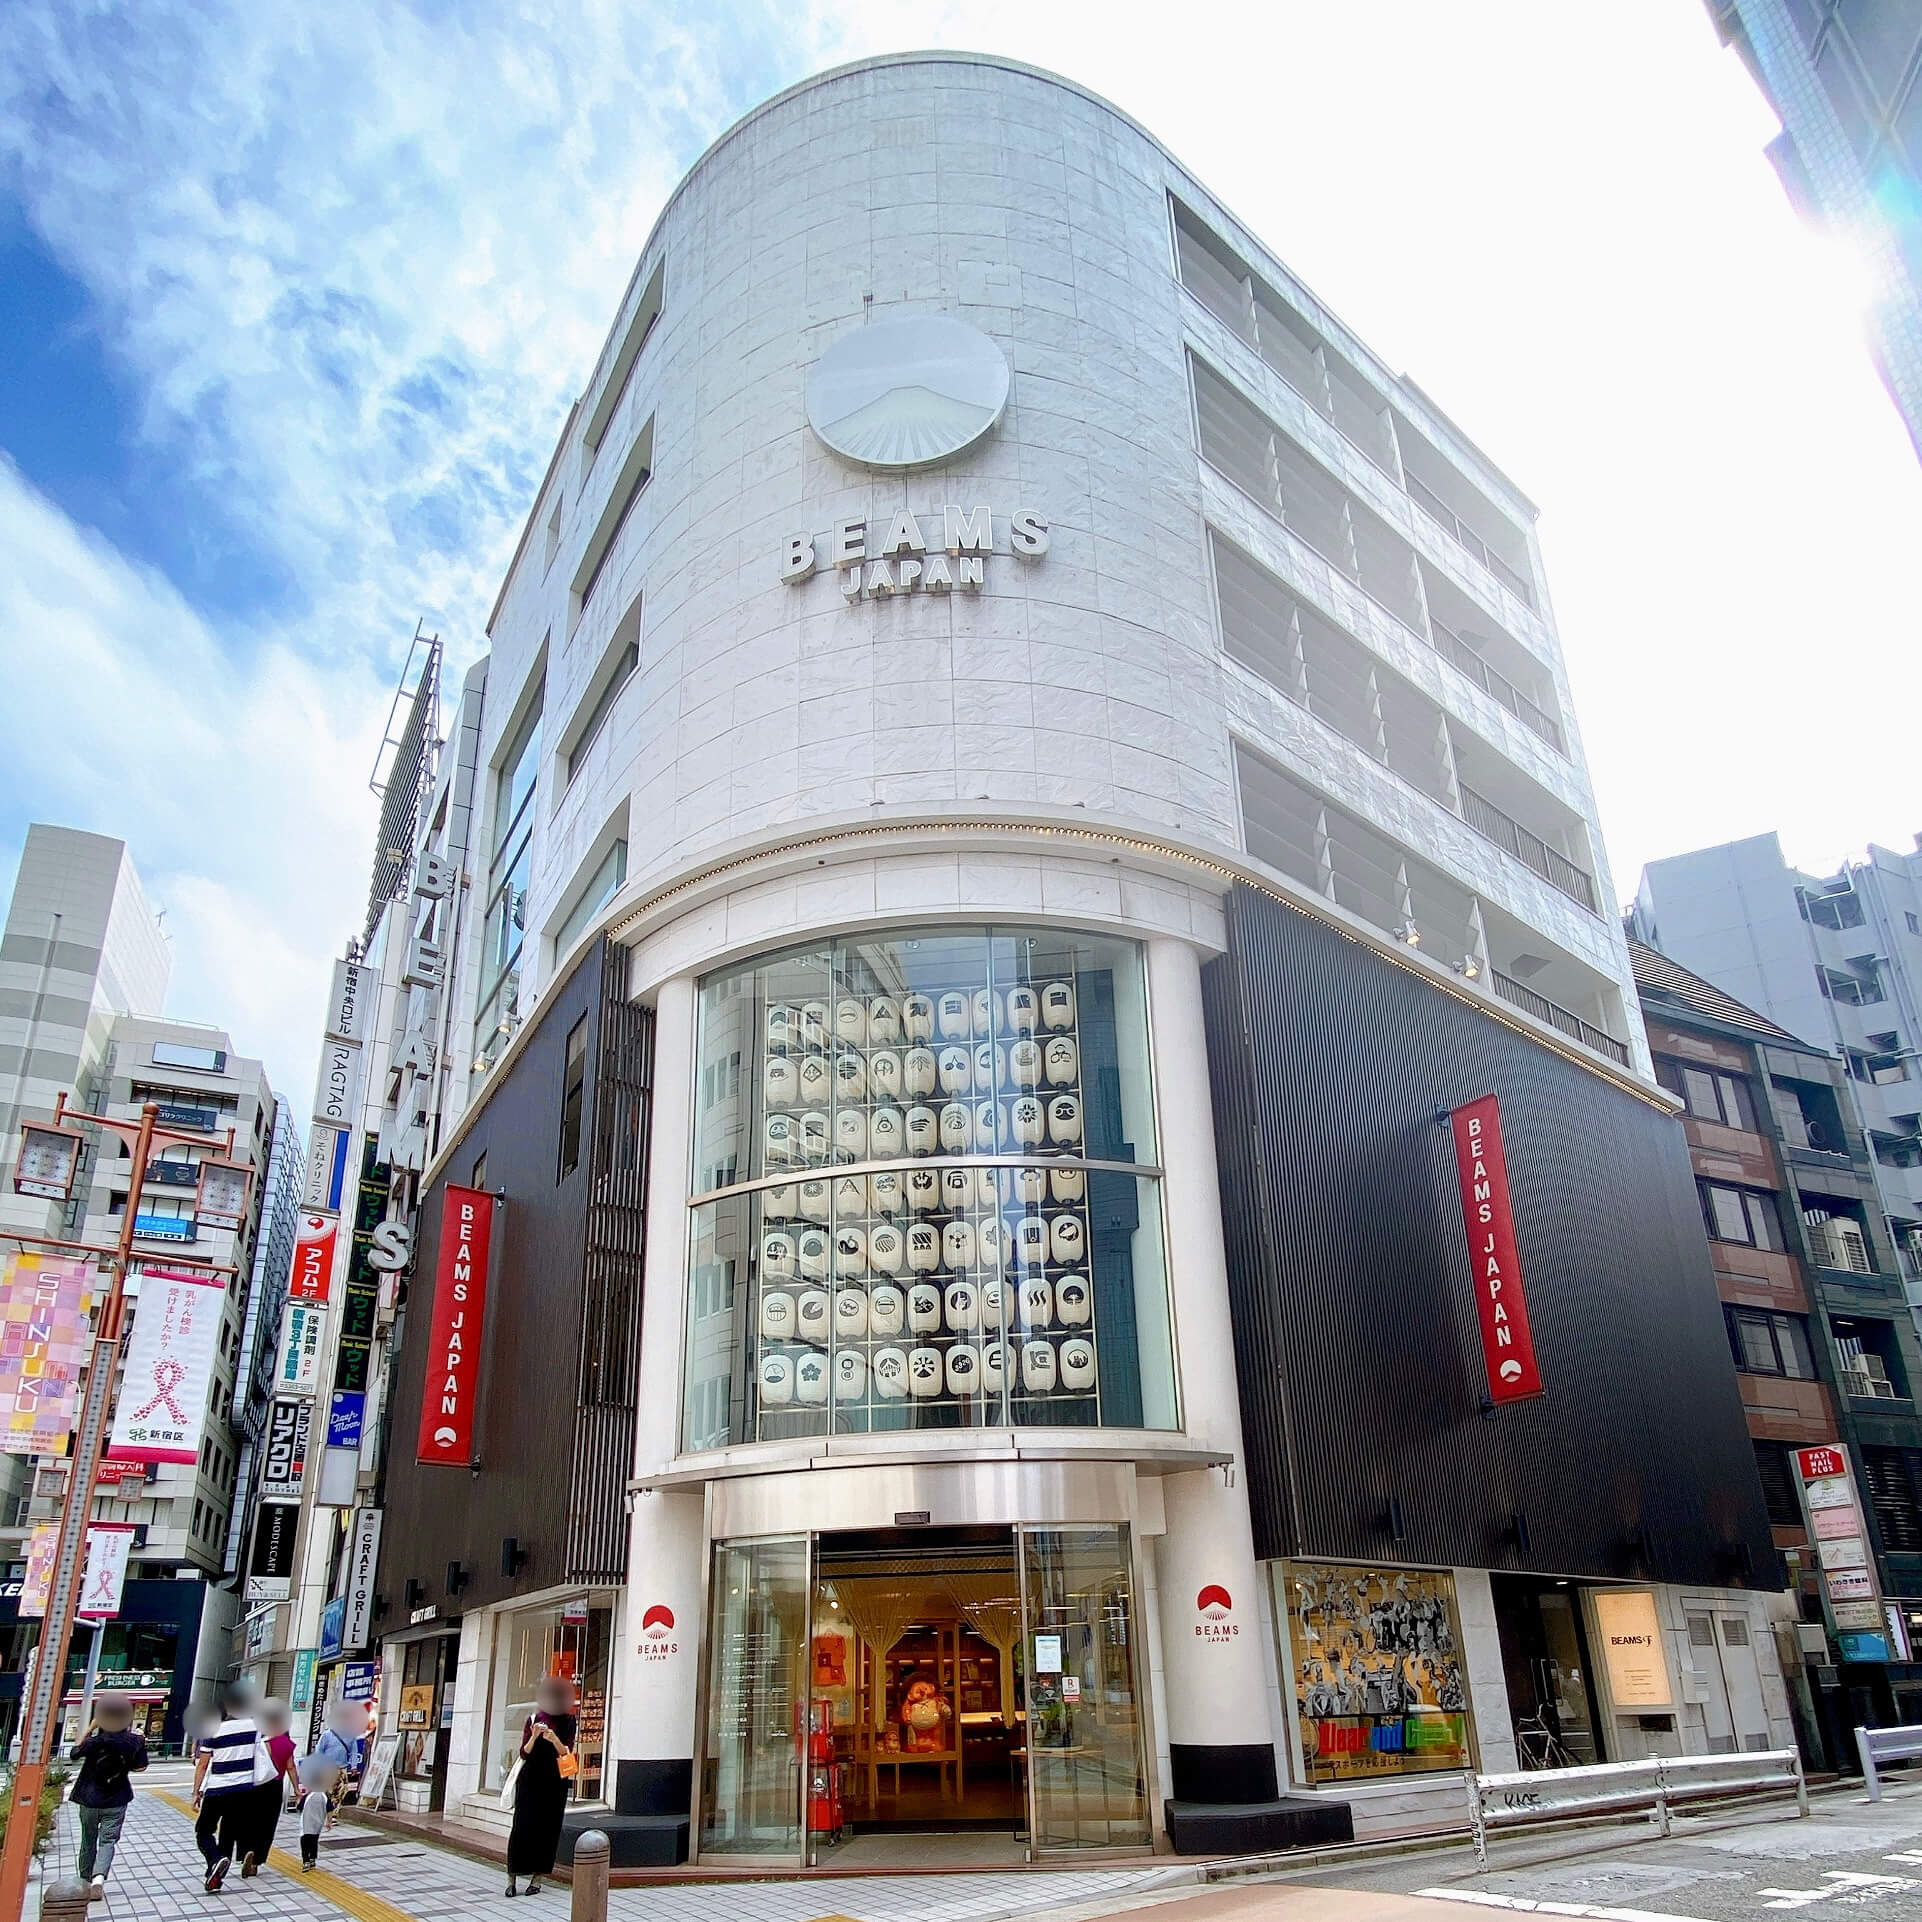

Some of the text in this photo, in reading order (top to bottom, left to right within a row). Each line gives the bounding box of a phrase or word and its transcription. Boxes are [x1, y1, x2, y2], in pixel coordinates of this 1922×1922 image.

[780, 505, 1049, 585] BEAMS
[840, 557, 984, 602] JAPAN
[326, 1047, 350, 1118] RAGTAG
[1468, 1118, 1511, 1347] BEAMS JAPAN
[302, 1247, 323, 1288] アコム
[301, 1288, 317, 1298] 2F
[441, 1204, 474, 1414] BEAMS JAPAN
[14, 1272, 62, 1413] SHINJUKU
[150, 1429, 184, 1442] 新宿区
[267, 1407, 295, 1479] リアクロ
[342, 1437, 358, 1446] BAR
[1808, 1450, 1831, 1460] FAST
[1810, 1458, 1833, 1468] NAIL
[1811, 1465, 1835, 1475] PLUS
[266, 1516, 282, 1573] MODESCAPE
[358, 1533, 373, 1586] CRAFT
[350, 1590, 367, 1644] GRILL
[1195, 1625, 1240, 1636] BEAMS
[637, 1643, 678, 1655] BEAMS
[1611, 1635, 1643, 1646] BEAMS
